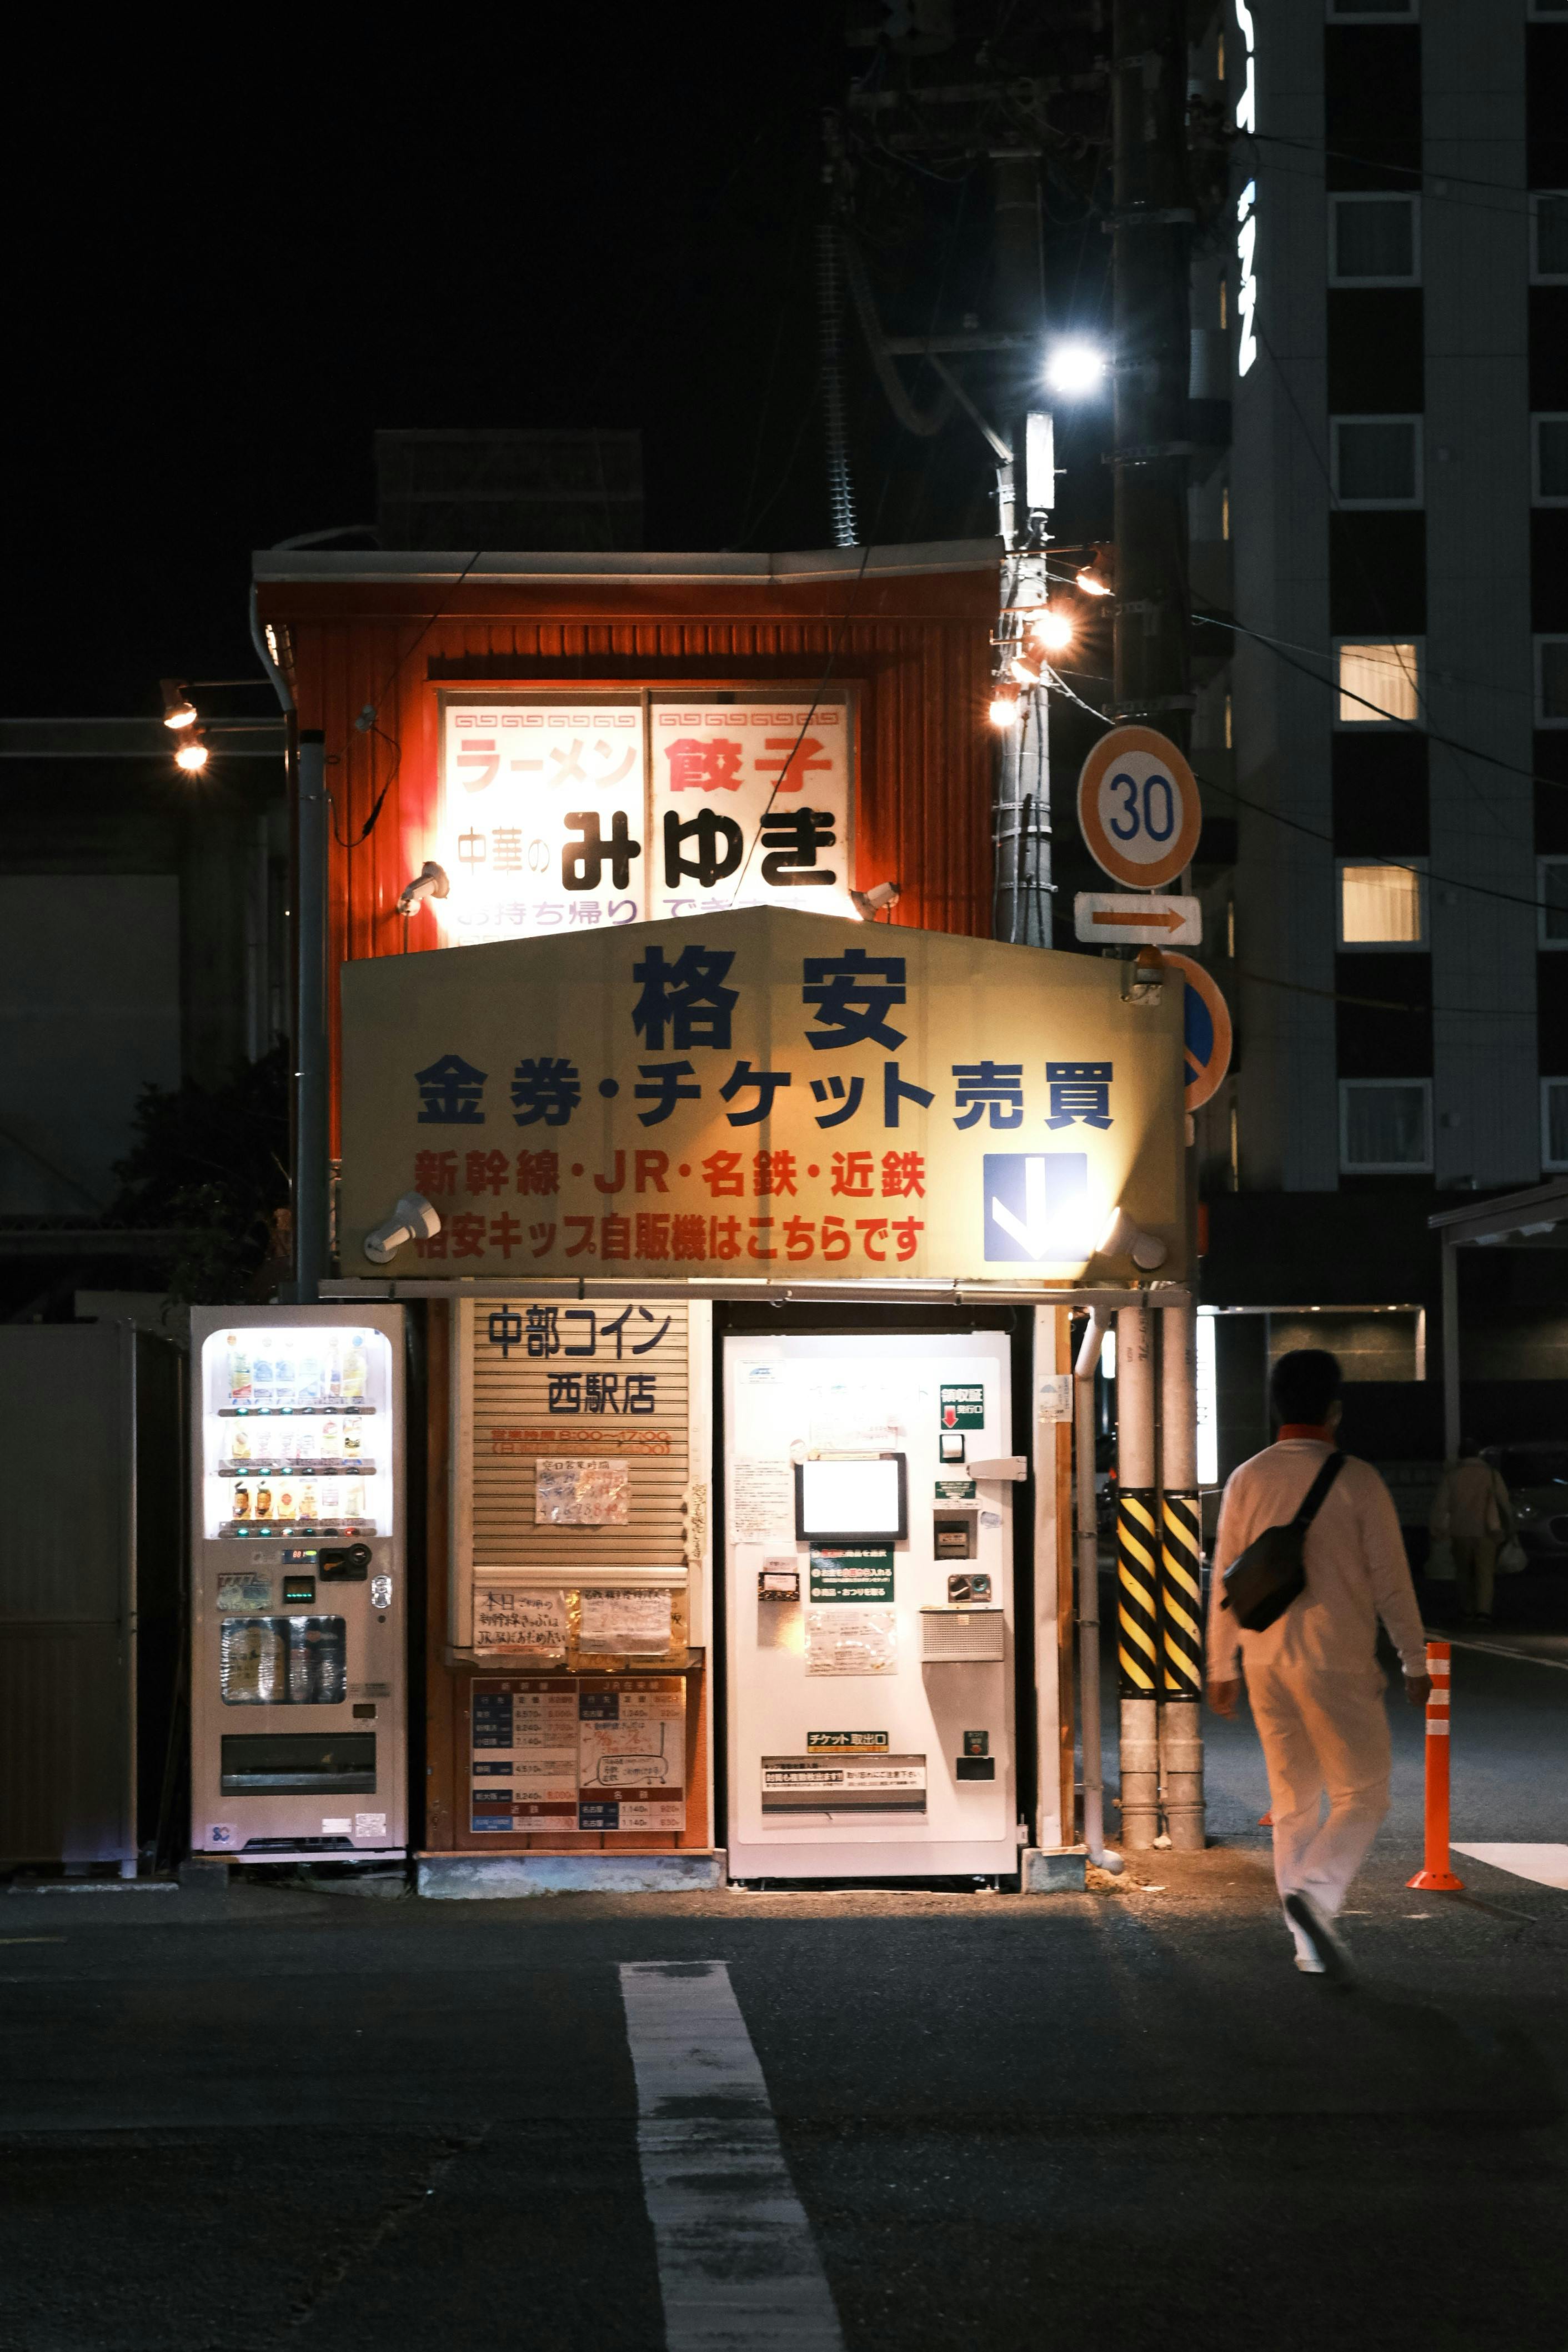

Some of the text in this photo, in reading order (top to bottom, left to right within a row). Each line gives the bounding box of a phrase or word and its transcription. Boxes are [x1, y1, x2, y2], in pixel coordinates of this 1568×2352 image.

[457, 739, 637, 793] ラーメン
[664, 738, 833, 793] 餃子
[1110, 773, 1174, 842] 30
[458, 808, 836, 891] 中華の みゆき
[632, 945, 908, 1052] 格安
[489, 1304, 672, 1359] 中部コイン
[547, 1372, 657, 1414] 西駅店
[810, 1733, 886, 1744] チケット 取出口
